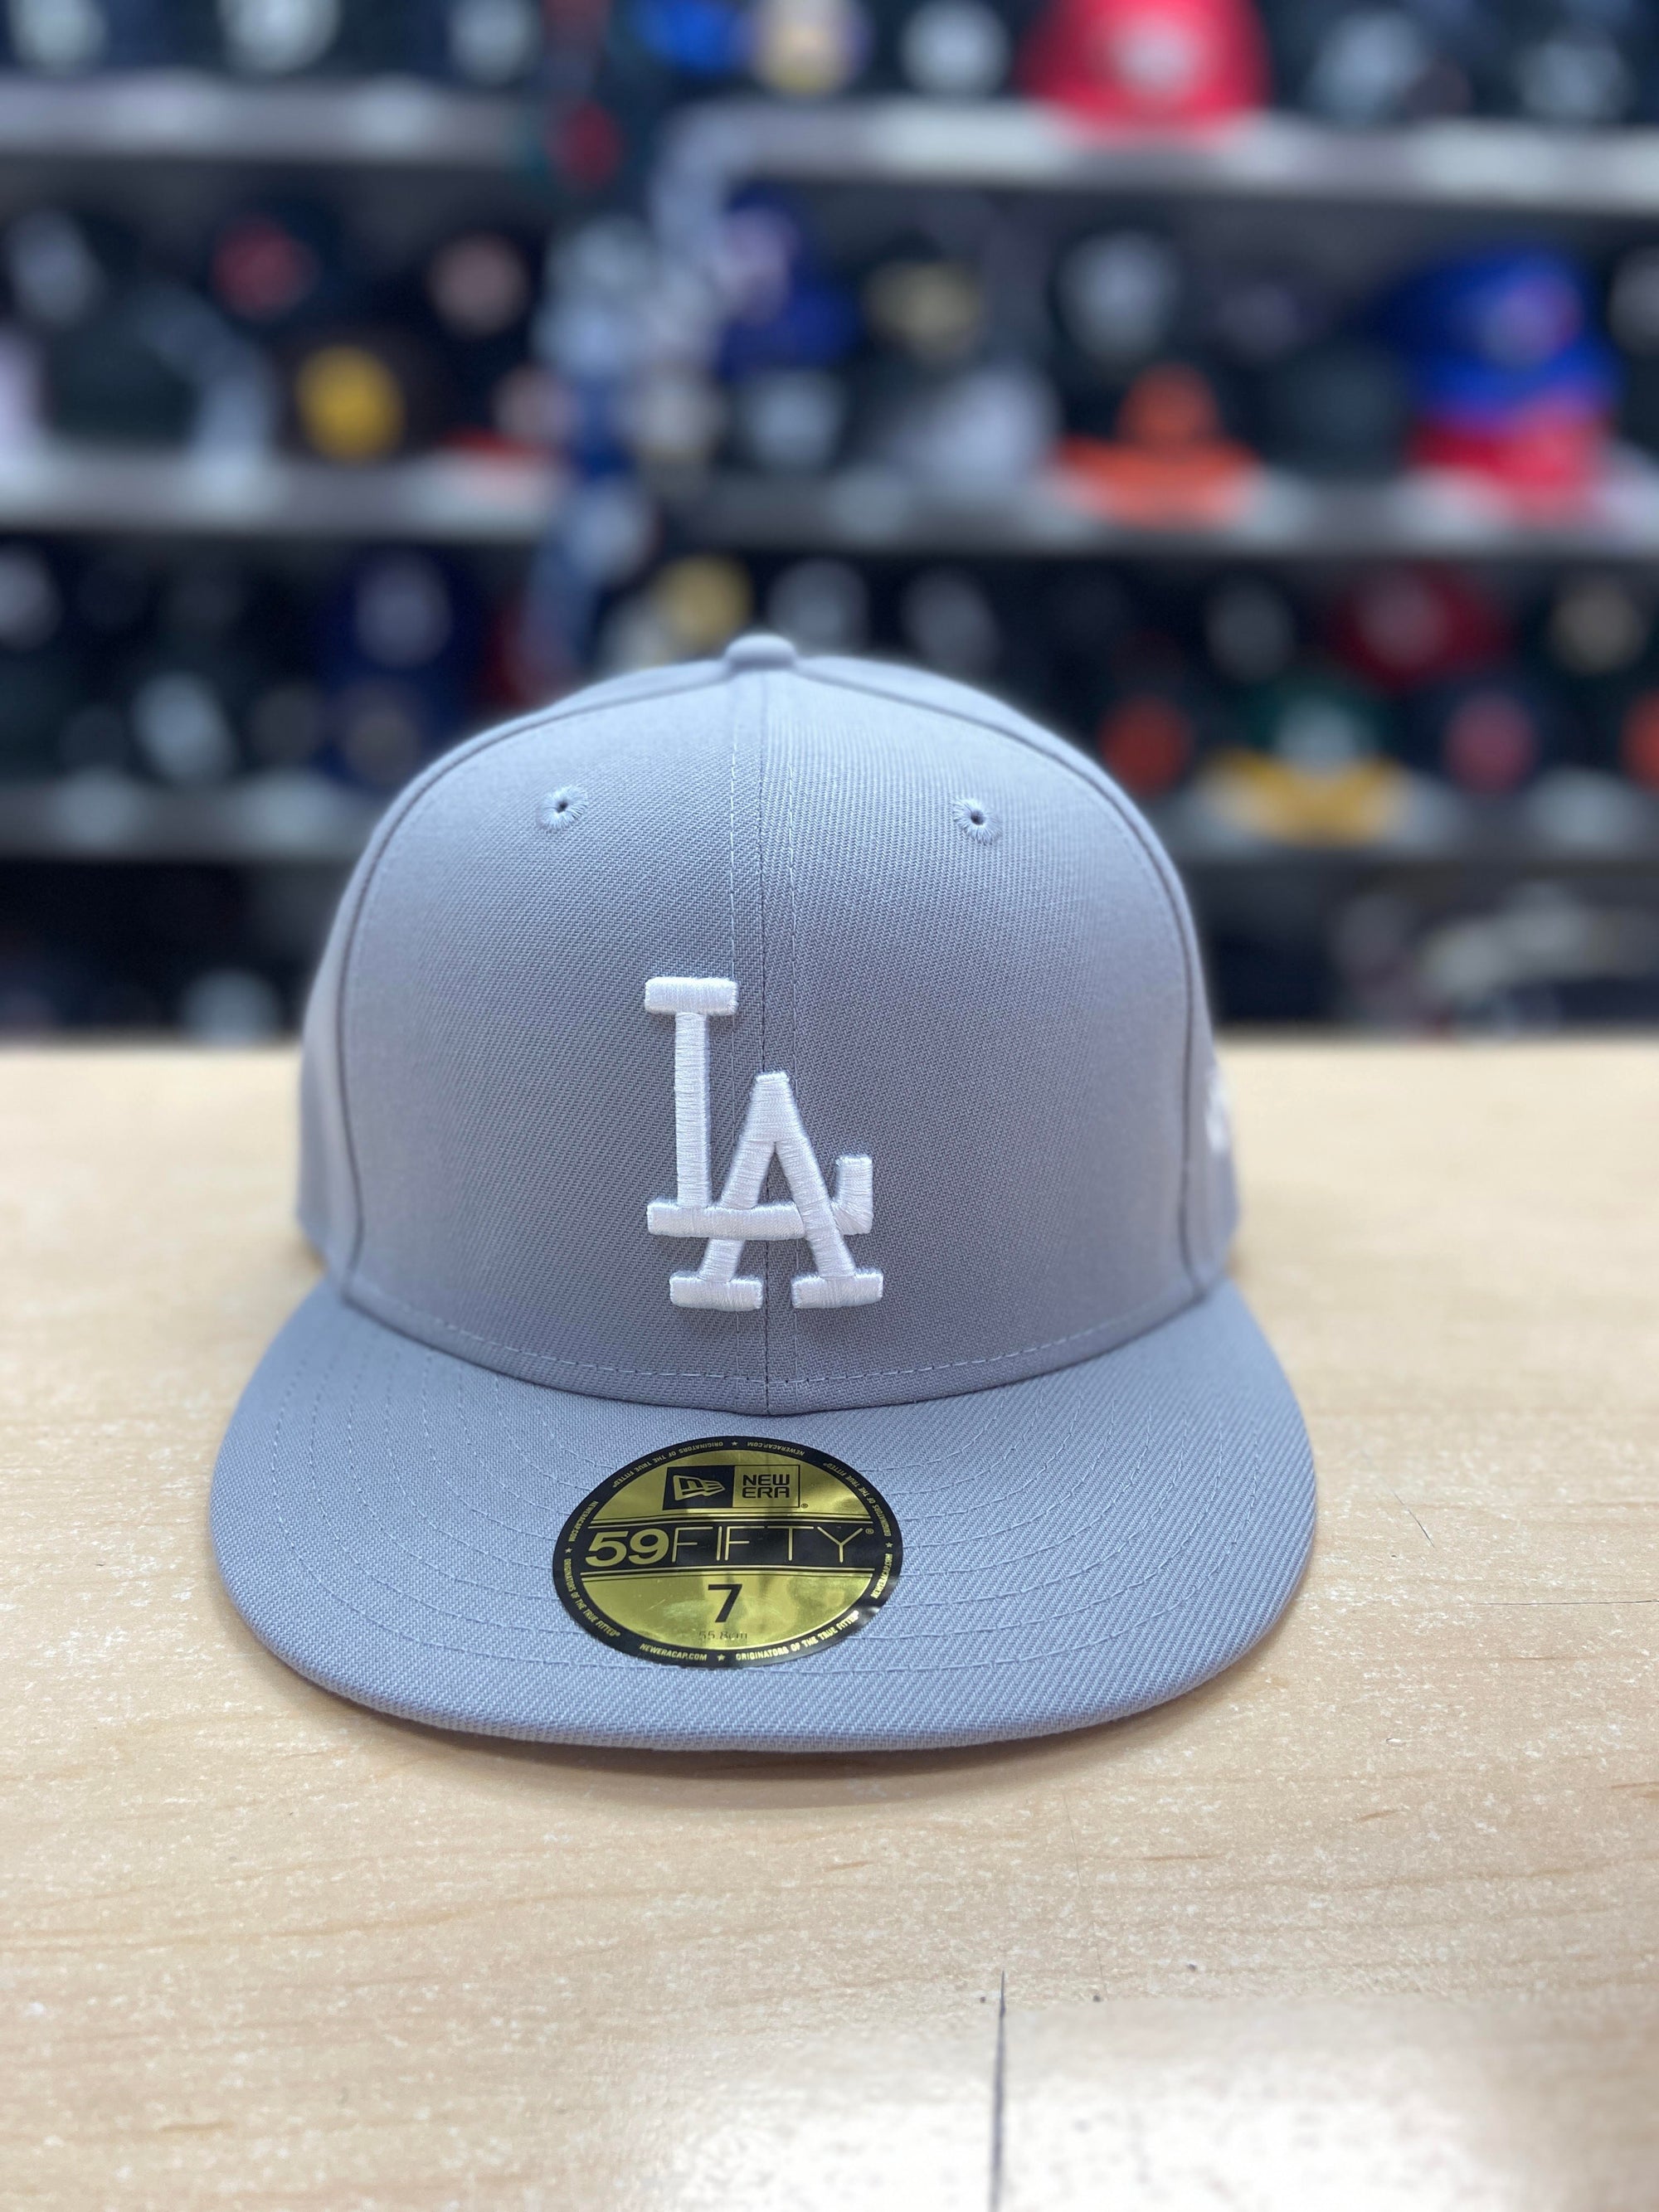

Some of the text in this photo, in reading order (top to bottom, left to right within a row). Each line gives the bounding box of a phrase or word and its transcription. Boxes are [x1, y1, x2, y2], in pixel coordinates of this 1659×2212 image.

[645, 976, 883, 1310] LA
[679, 1441, 723, 1454] ORIGINATORS
[747, 1441, 805, 1456] NEWERACAP.COM
[653, 1456, 667, 1464] THE
[668, 1451, 677, 1459] OF
[634, 1461, 652, 1472] TRUE
[742, 1474, 790, 1486] NEW
[844, 1475, 861, 1488] TRUE
[742, 1486, 790, 1499] ERA
[859, 1485, 870, 1498] THE
[576, 1596, 586, 1611] THE
[583, 1607, 599, 1623] TRUE
[708, 1584, 742, 1623] 7
[736, 1648, 789, 1660] ORIGINATORS
[791, 1642, 800, 1651] OF
[802, 1636, 819, 1647] THE
[818, 1627, 839, 1641] TRUE
[640, 1643, 708, 1661] NEWERACAP.COM
